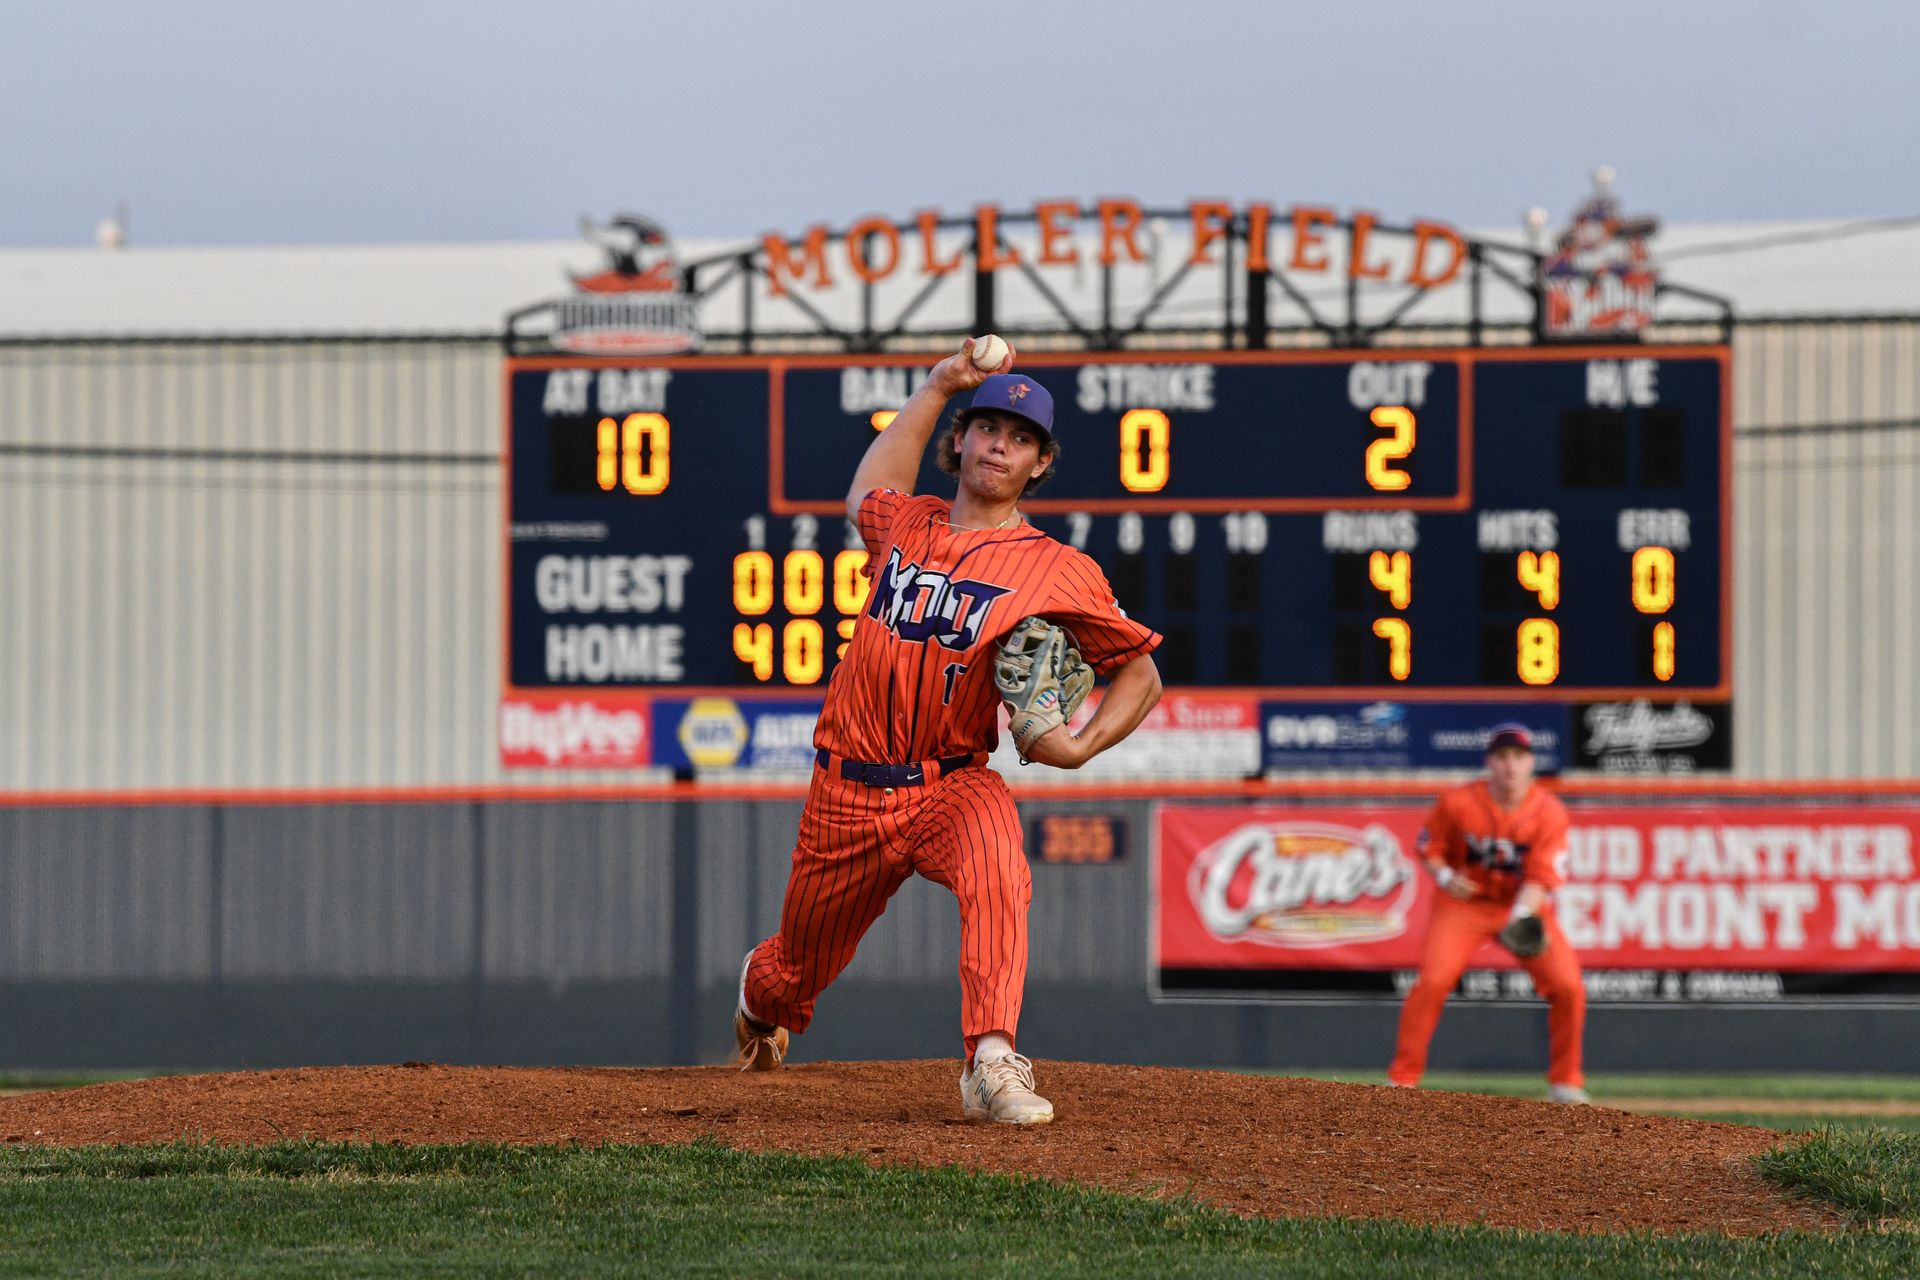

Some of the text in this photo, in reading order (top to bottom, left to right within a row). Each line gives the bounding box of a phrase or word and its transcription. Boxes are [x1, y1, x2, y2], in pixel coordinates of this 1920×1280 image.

[760, 197, 1469, 297] MOLLER FIELD
[542, 367, 672, 415] AT BAT
[1077, 363, 1216, 411] STRIKE
[1348, 361, 1432, 409] OUT
[1585, 359, 1660, 408] H/E
[596, 412, 670, 495] 10
[1120, 409, 1170, 492] 0
[1365, 406, 1416, 490] 2
[744, 514, 766, 551] 1
[791, 514, 819, 551] 2
[1067, 511, 1092, 551] 7
[1117, 511, 1144, 554] 8
[1169, 511, 1196, 554] 9
[1221, 511, 1268, 553] 10
[1322, 511, 1420, 551] RUNS
[1477, 509, 1560, 550] HITS
[1617, 508, 1692, 551] ERR
[535, 553, 692, 614] GUEST
[1368, 550, 1411, 611] 4
[1517, 550, 1560, 611] 4
[1631, 546, 1675, 614] 0
[545, 624, 684, 683] HOME
[1372, 618, 1411, 681] 7
[1517, 618, 1560, 685] 8
[1653, 621, 1675, 682] 1
[942, 663, 969, 705] 1
[1203, 823, 1412, 935] Cane's
[1651, 826, 1914, 880] PARTNER
[1556, 881, 1819, 950] EMONT
